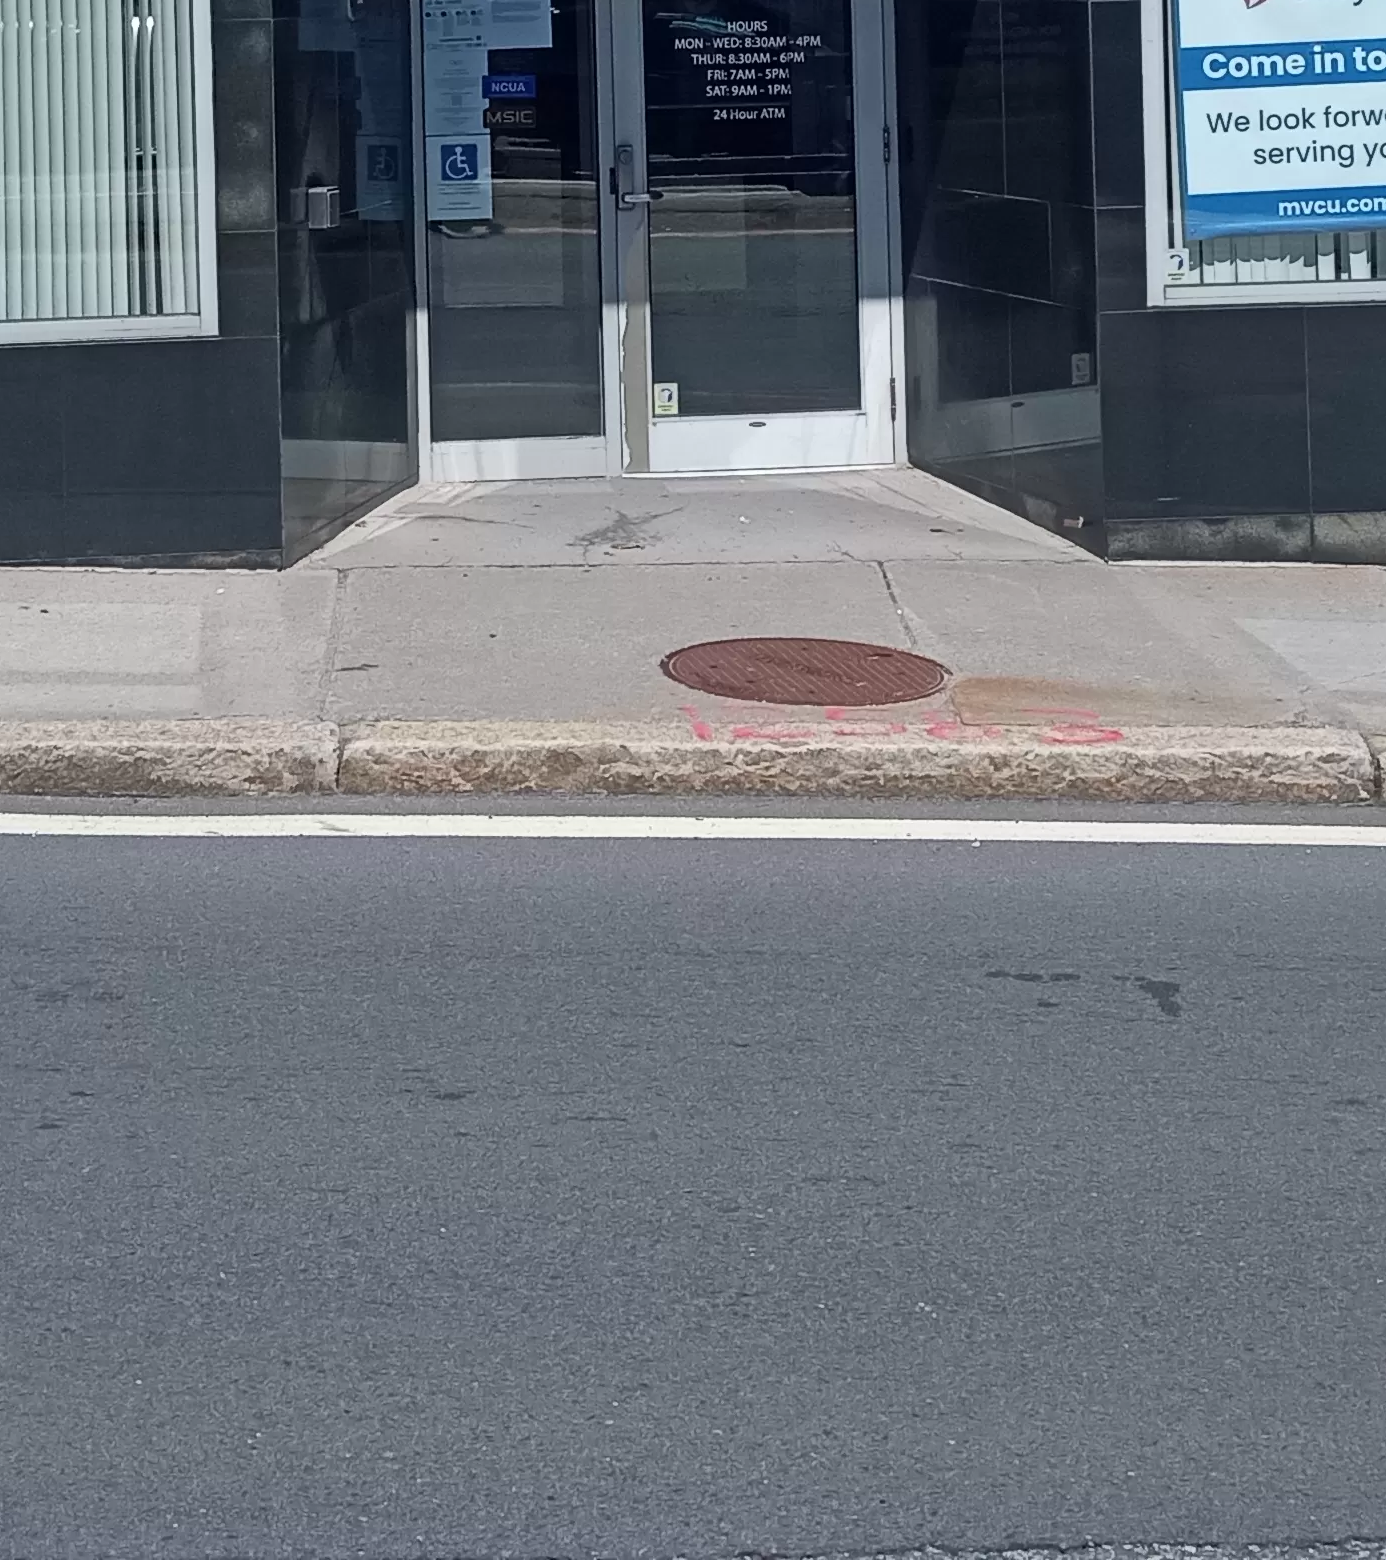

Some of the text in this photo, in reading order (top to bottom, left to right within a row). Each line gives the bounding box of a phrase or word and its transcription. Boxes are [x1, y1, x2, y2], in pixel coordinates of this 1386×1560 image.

[727, 21, 768, 33] HOURS
[674, 38, 704, 50] MON
[713, 37, 743, 49] WED:
[744, 36, 787, 48] 8:30AM
[796, 35, 821, 47] 4PM
[691, 53, 726, 65] THUR:
[779, 52, 805, 63] 6PM
[1203, 49, 1307, 79] Come
[1314, 45, 1344, 74] in
[707, 70, 727, 81] FRI:
[730, 69, 756, 80] 7AM
[765, 68, 790, 79] 5PM
[492, 82, 526, 92] NCUA
[706, 85, 730, 96] SAT:
[731, 85, 758, 96] 9AM
[768, 84, 792, 95] 1PM
[486, 110, 533, 123] MSIC
[713, 108, 786, 120] 24 Hour ATM
[1206, 111, 1250, 133] We
[1259, 107, 1315, 131] look
[1253, 139, 1355, 168] serving
